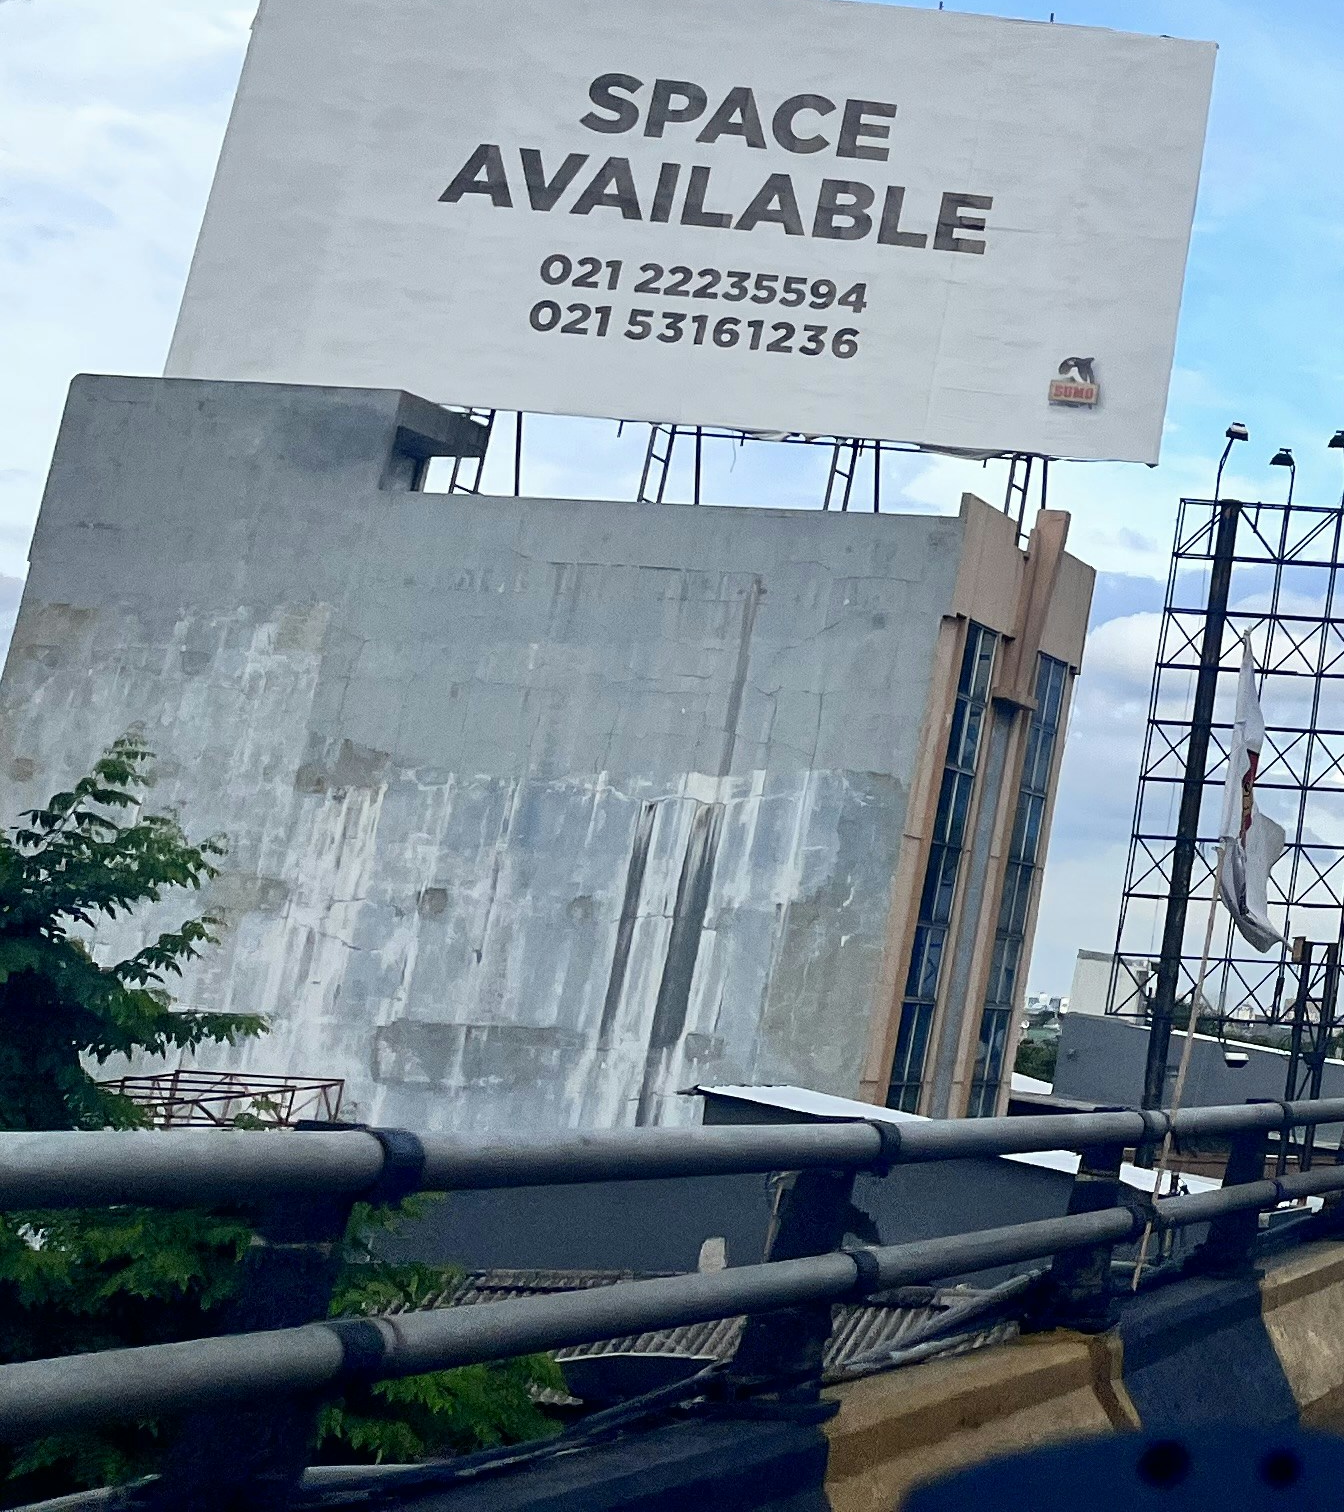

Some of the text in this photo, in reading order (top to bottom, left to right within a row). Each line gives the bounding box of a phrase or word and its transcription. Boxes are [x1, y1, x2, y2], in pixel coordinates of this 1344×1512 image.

[579, 73, 898, 162] SPACE
[437, 143, 994, 255] AVAILABLE
[540, 253, 868, 314] 021 22235594
[529, 299, 860, 359] 021 53161236
[1053, 383, 1094, 400] SUMO
